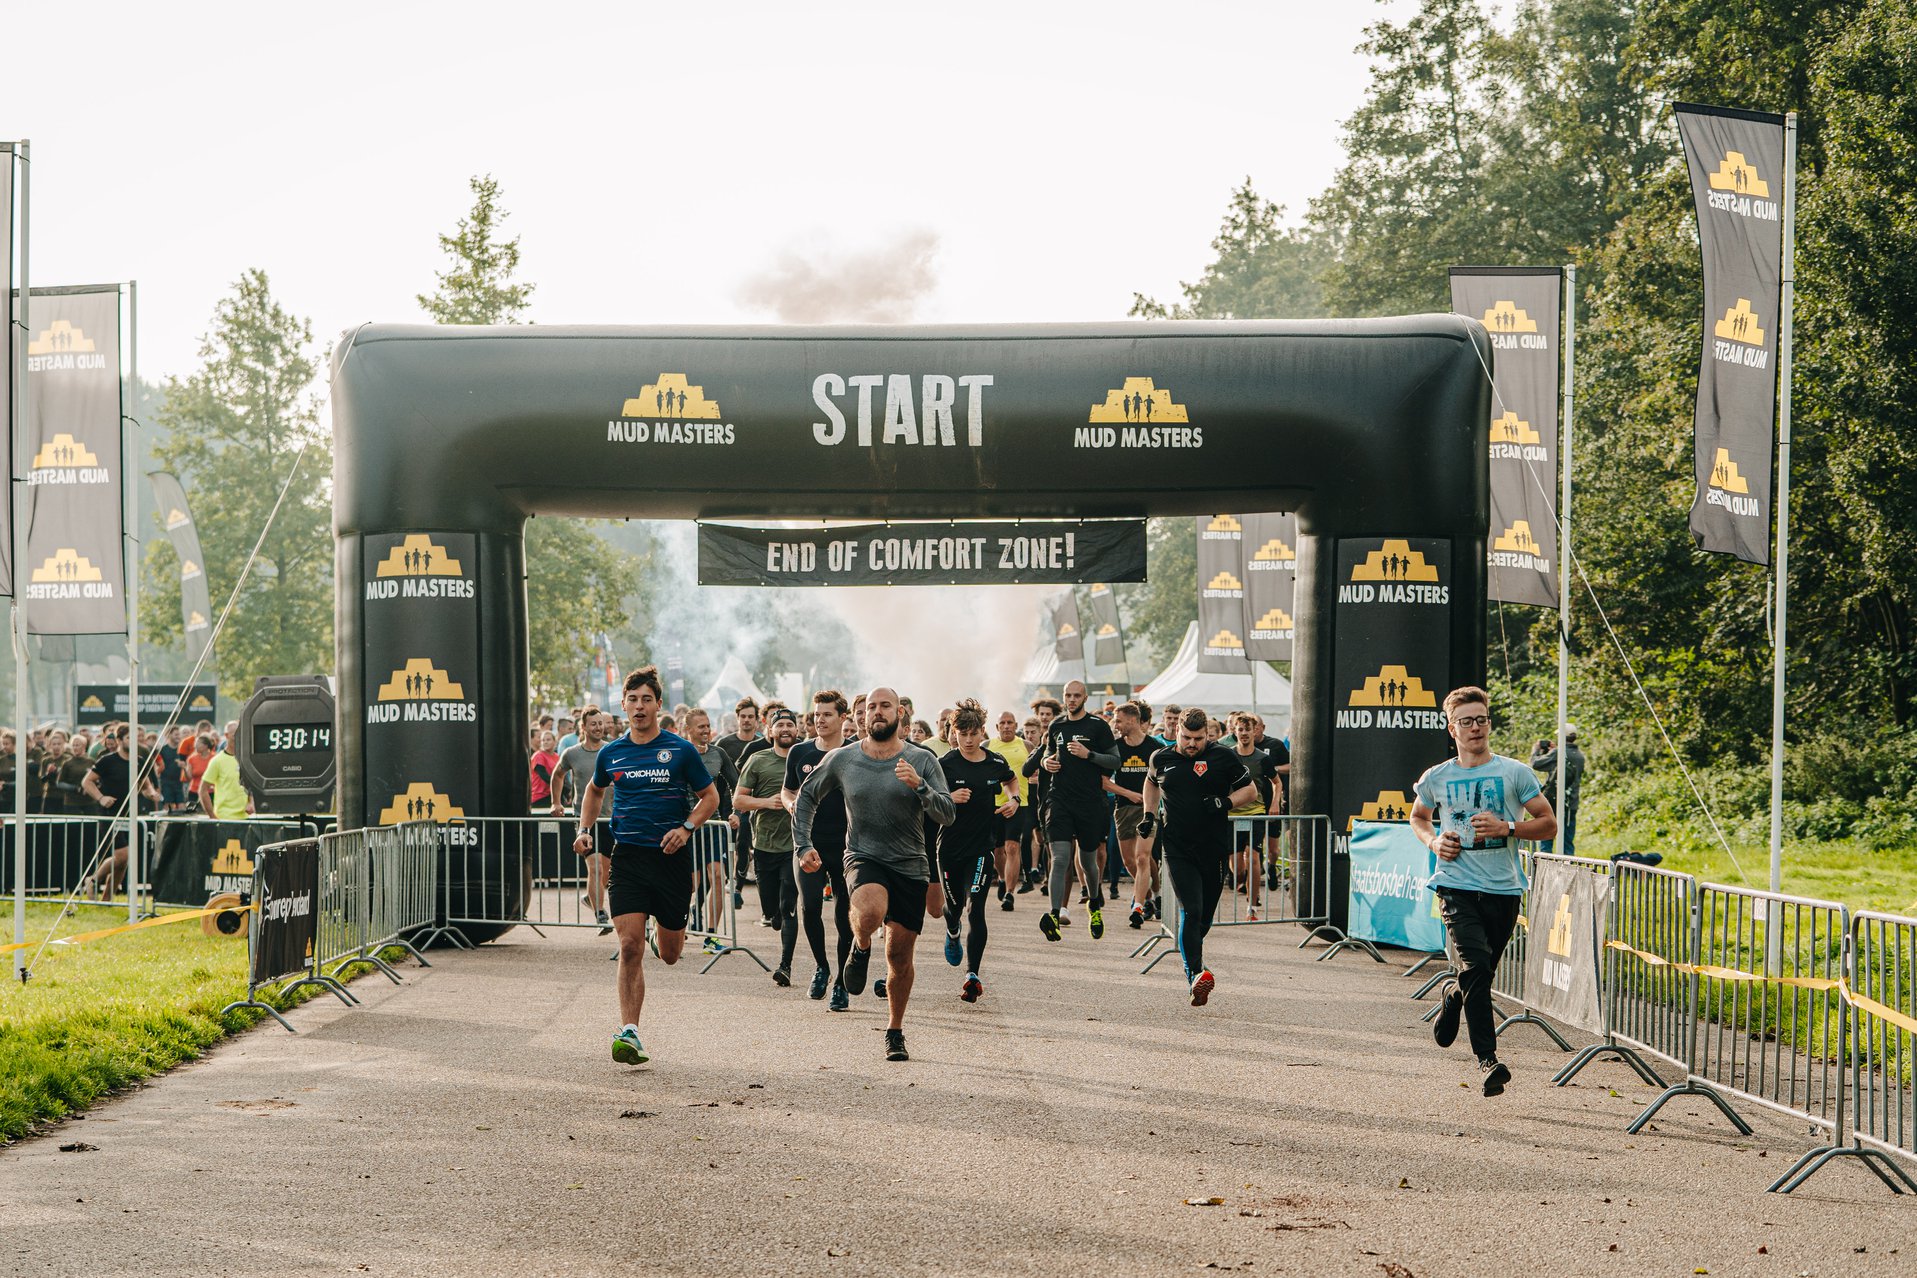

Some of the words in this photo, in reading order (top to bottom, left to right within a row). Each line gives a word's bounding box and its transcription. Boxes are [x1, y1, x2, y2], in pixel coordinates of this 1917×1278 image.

[812, 373, 994, 446] START
[607, 421, 650, 443] MUD
[654, 422, 735, 445] MASTERS
[1074, 427, 1116, 448] MUD
[1121, 427, 1204, 449] MASTERS
[767, 542, 816, 572] END
[828, 541, 858, 572] OF
[869, 538, 987, 570] COMFORT
[998, 533, 1075, 570] ZONE!
[366, 580, 399, 600] MUD
[402, 578, 475, 599] MASTERS
[1338, 585, 1375, 603] MUD
[1378, 584, 1449, 604] MASTERS
[367, 703, 401, 724] MUD
[404, 702, 477, 722] MASTERS
[1336, 710, 1373, 728] MUD
[1376, 710, 1447, 730] MASTERS
[269, 728, 330, 750] 9:30:14
[624, 769, 670, 779] YOKOHAMA
[223, 876, 252, 893] MASTE
